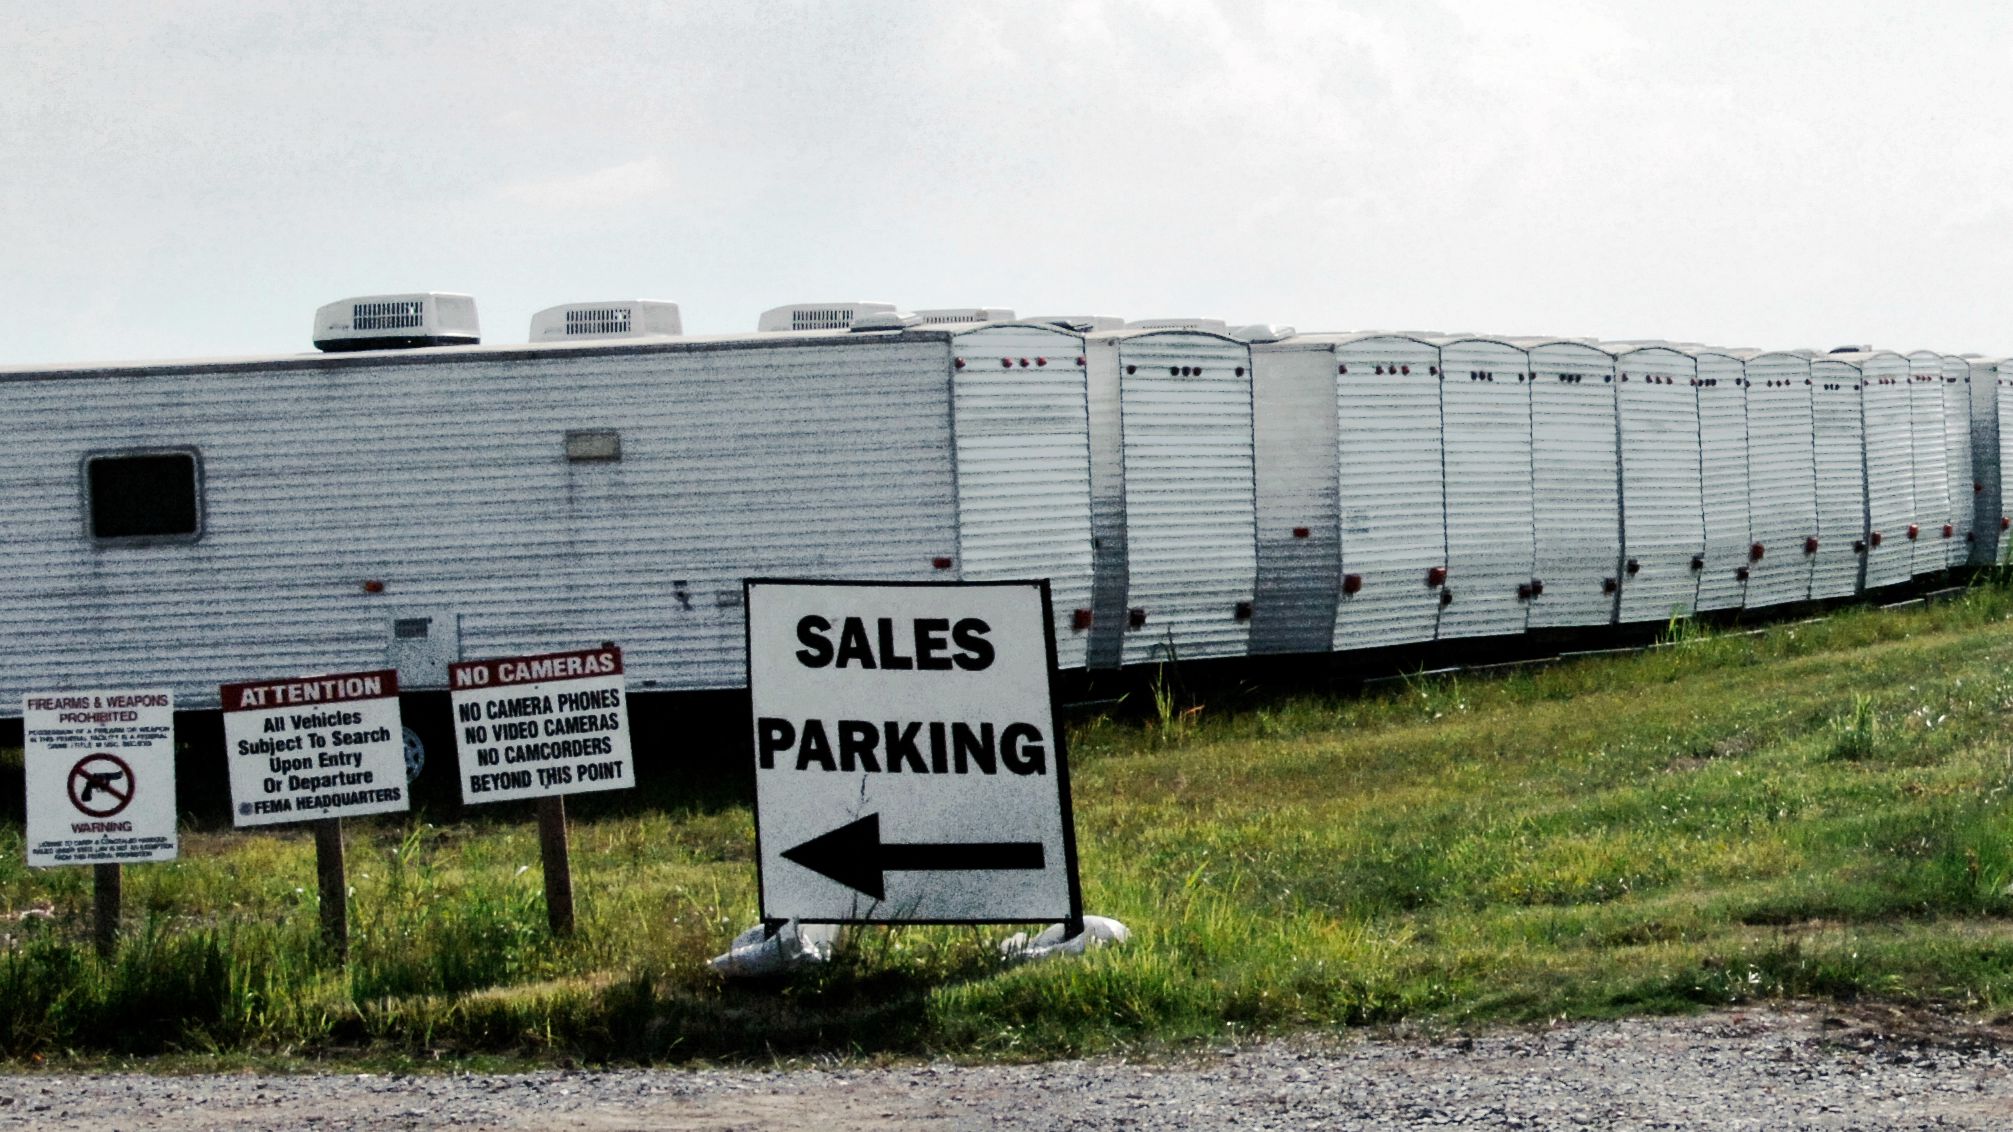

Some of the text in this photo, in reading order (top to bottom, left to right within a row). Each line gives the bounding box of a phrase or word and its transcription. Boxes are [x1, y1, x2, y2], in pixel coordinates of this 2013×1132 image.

[795, 614, 996, 671] SALES
[456, 652, 615, 686] NO CAMERAS
[28, 694, 168, 710] FIREARMS & WEAPONS
[240, 676, 382, 708] ATTENTION
[458, 688, 620, 722] NO CAMERA PHONES
[60, 710, 138, 723] PROHIBITED
[264, 710, 362, 733] All Vehicles
[465, 712, 619, 744] NO VIDEO CAMERAS
[238, 726, 390, 756] Subject To Search
[477, 736, 612, 766] NO CAMCORDERS
[757, 716, 1046, 776] PARKING
[270, 750, 362, 775] Upon Entry
[470, 760, 624, 793] BEYOND THIS POINT
[264, 770, 373, 794] Or Departure
[254, 788, 402, 814] FEMA HEADQUARTERS
[72, 821, 132, 834] WARNING
